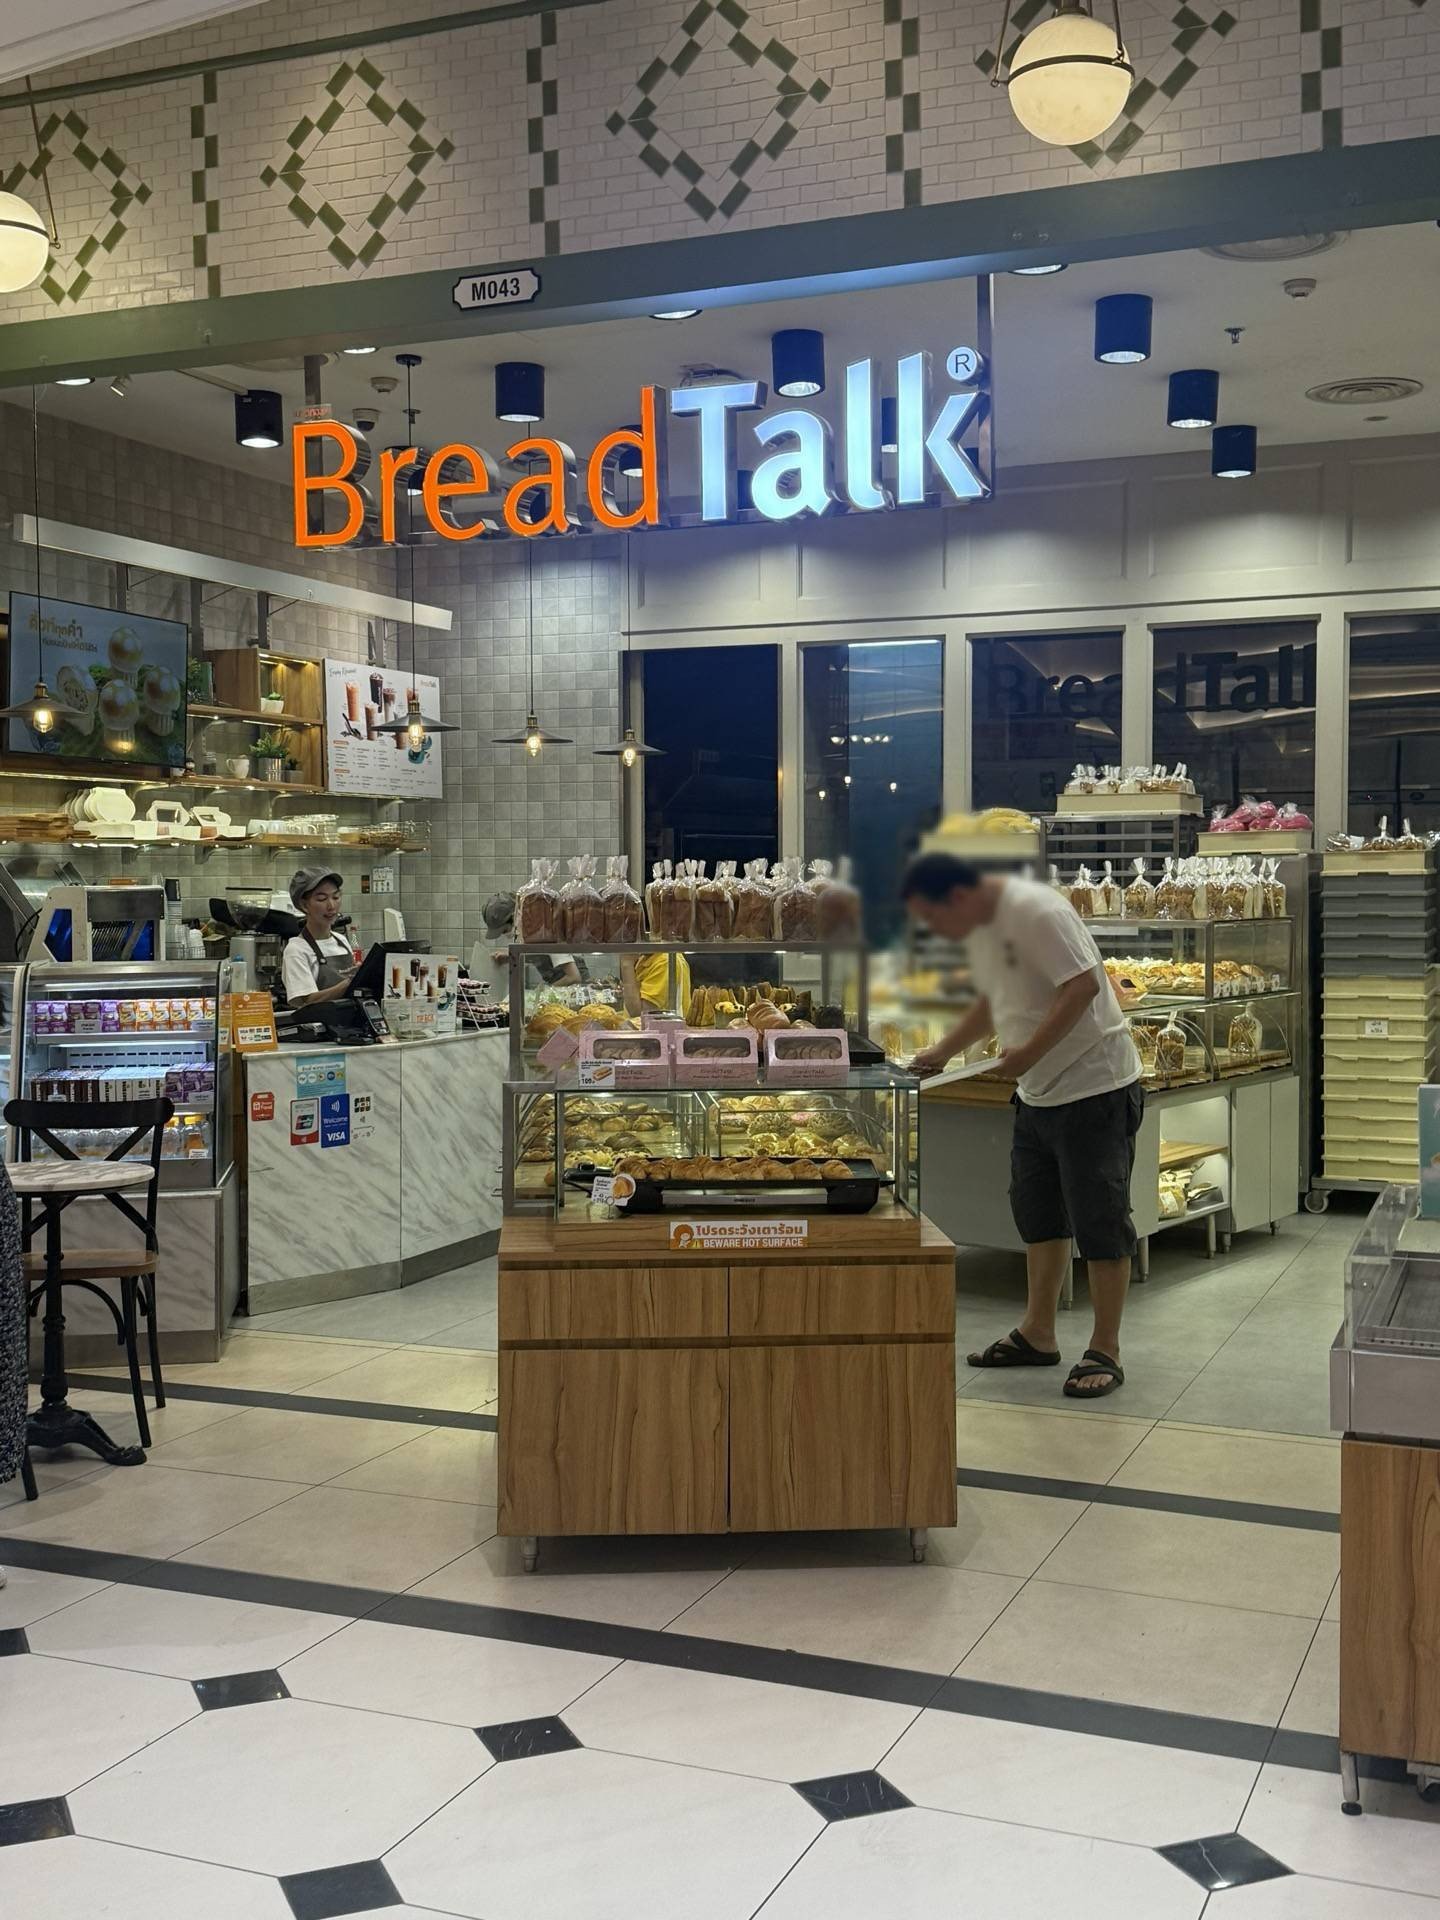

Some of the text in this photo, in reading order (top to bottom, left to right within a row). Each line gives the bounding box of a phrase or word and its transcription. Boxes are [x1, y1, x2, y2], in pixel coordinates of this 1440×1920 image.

[471, 277, 520, 301] M043
[293, 351, 989, 548] BreadTalk
[326, 1131, 346, 1141] VISA
[703, 1238, 804, 1248] BEWARE HOT SURFACE
